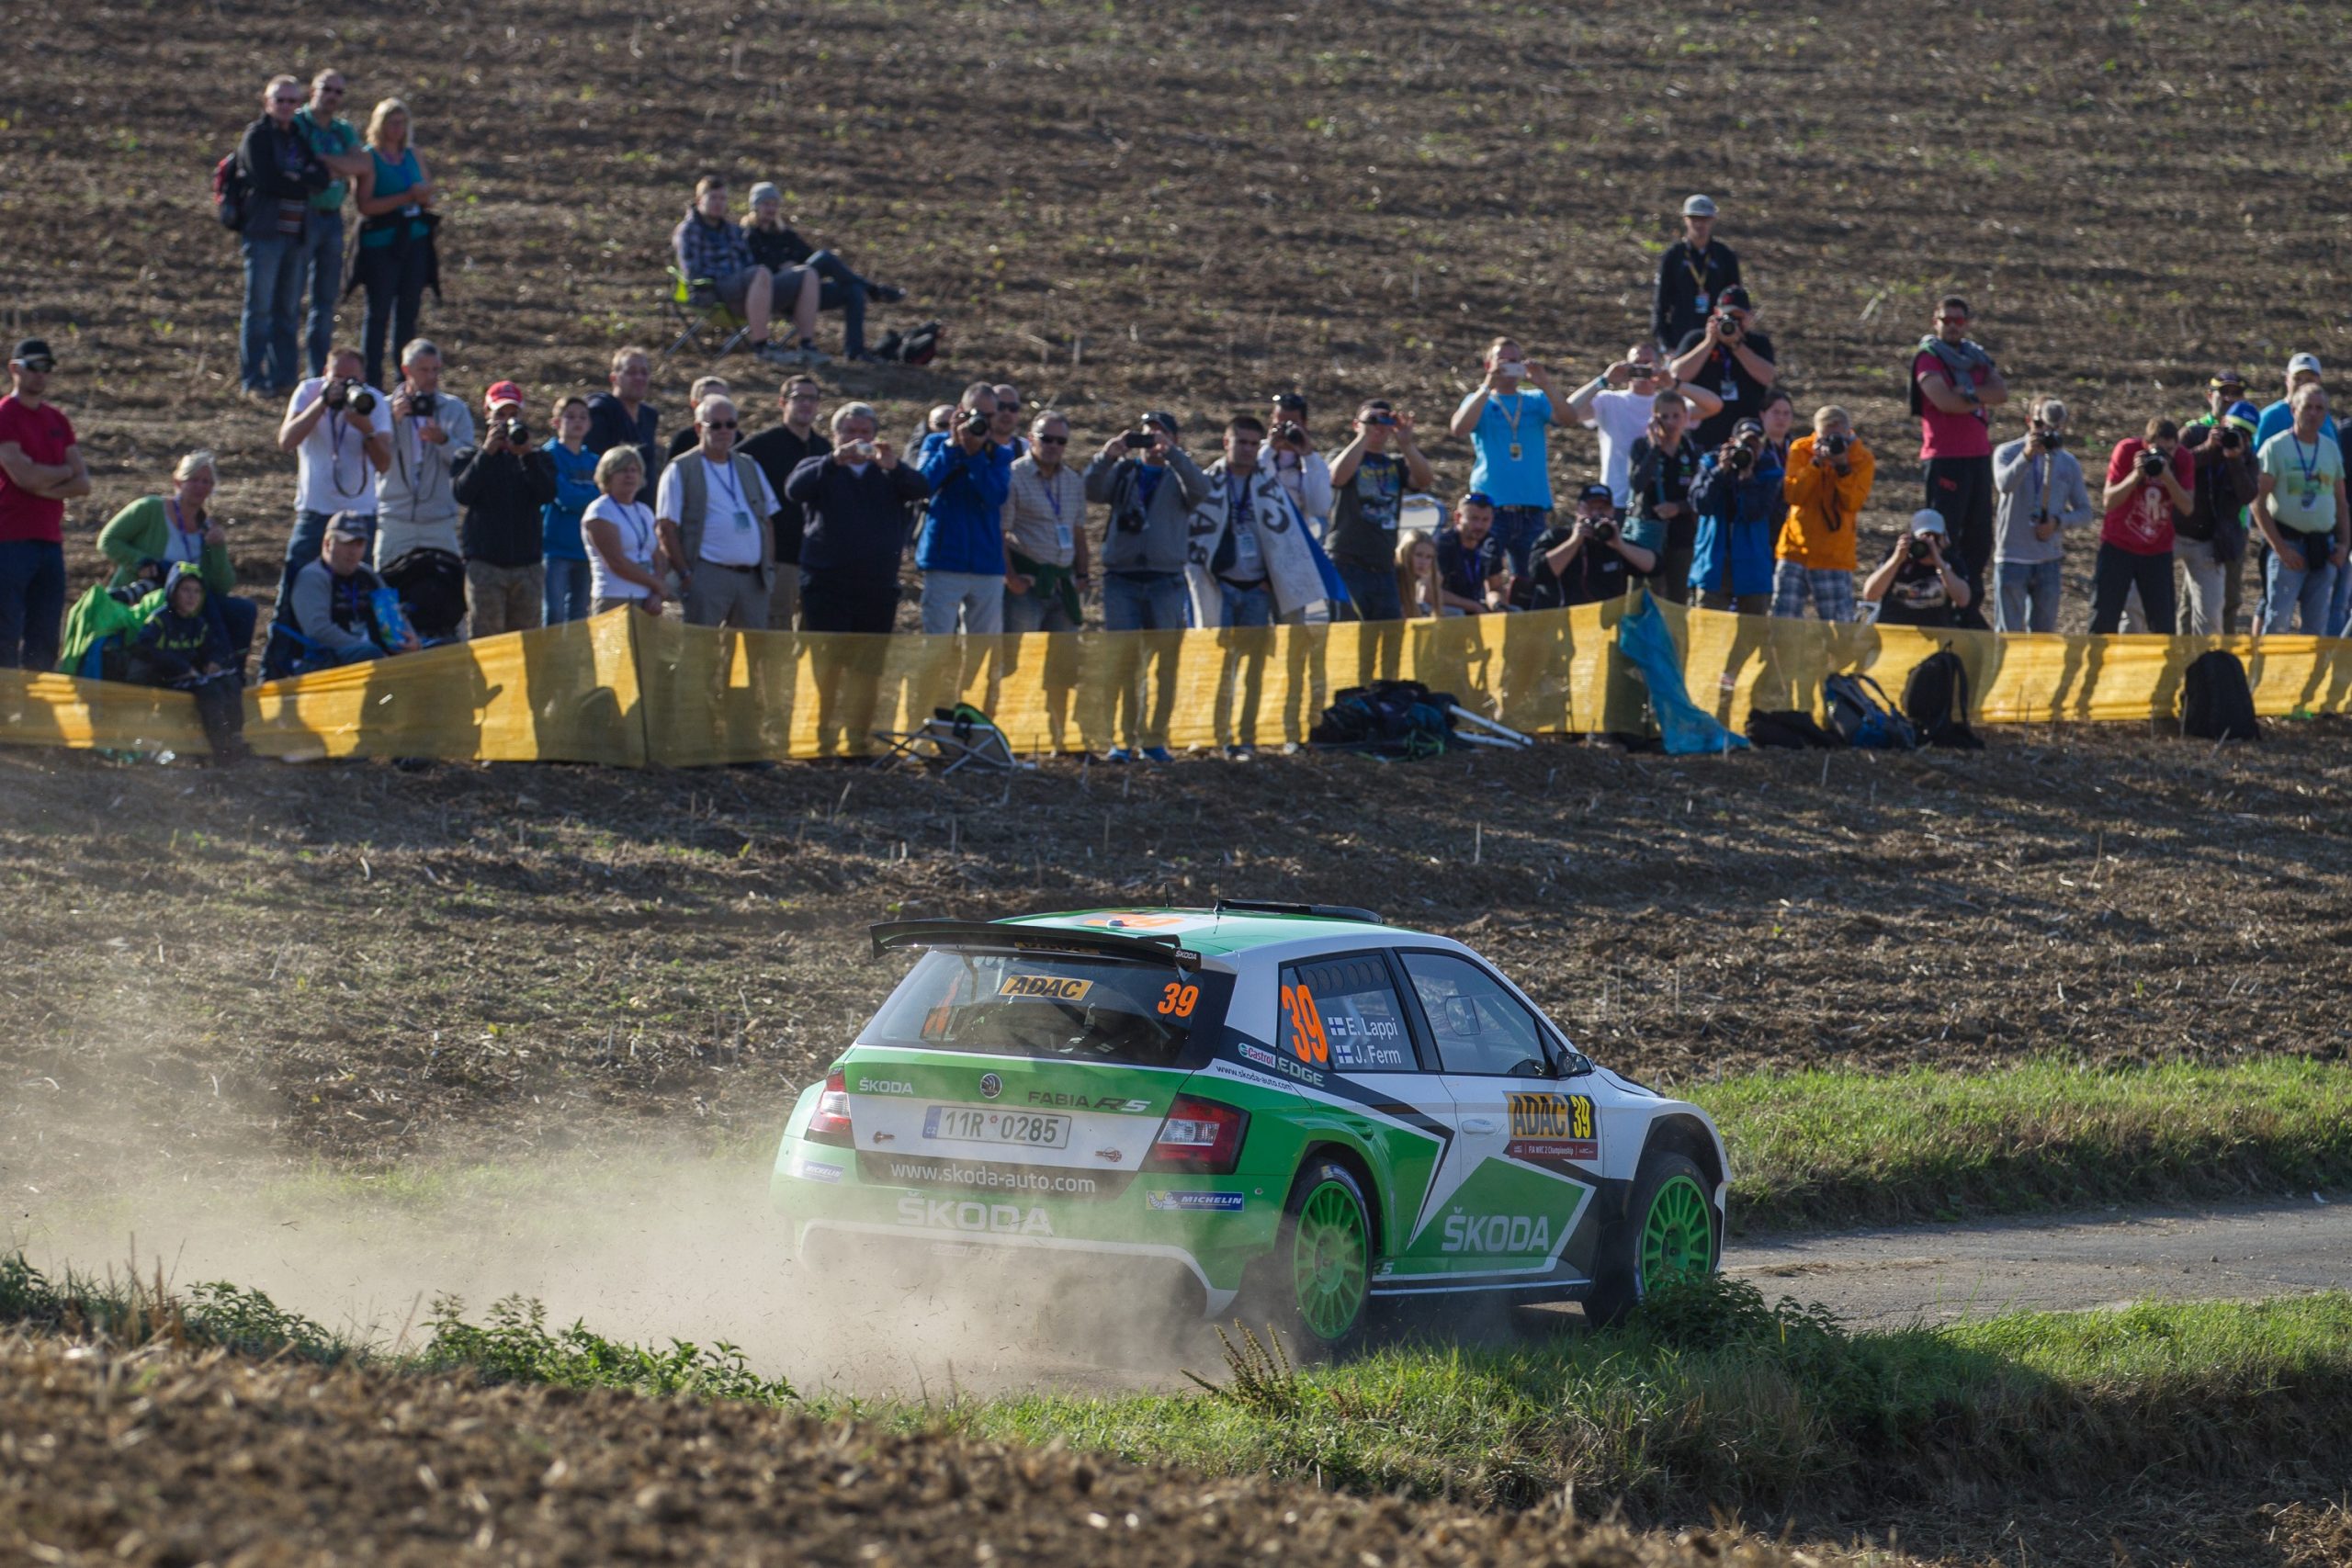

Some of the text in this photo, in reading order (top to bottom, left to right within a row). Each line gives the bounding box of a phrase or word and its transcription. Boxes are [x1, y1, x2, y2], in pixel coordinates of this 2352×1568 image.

[1007, 976, 1082, 998] ADAC
[1158, 982, 1199, 1017] 39
[1282, 985, 1329, 1063] 39
[1346, 1017, 1398, 1040] E. Lappi
[1248, 1047, 1325, 1088] Castrol EDGE
[1355, 1045, 1402, 1064] J. Ferm
[859, 1078, 913, 1094] ŠKODA
[1028, 1091, 1090, 1108] FABIA
[945, 1111, 1059, 1143] 11R 0285
[1512, 1095, 1590, 1138] ADAC 39
[889, 1163, 1096, 1193] www.skoda-auto.com
[897, 1191, 1054, 1235] ŠKODA
[1181, 1196, 1242, 1205] MICHELIN
[1441, 1206, 1550, 1252] ŠKODA
